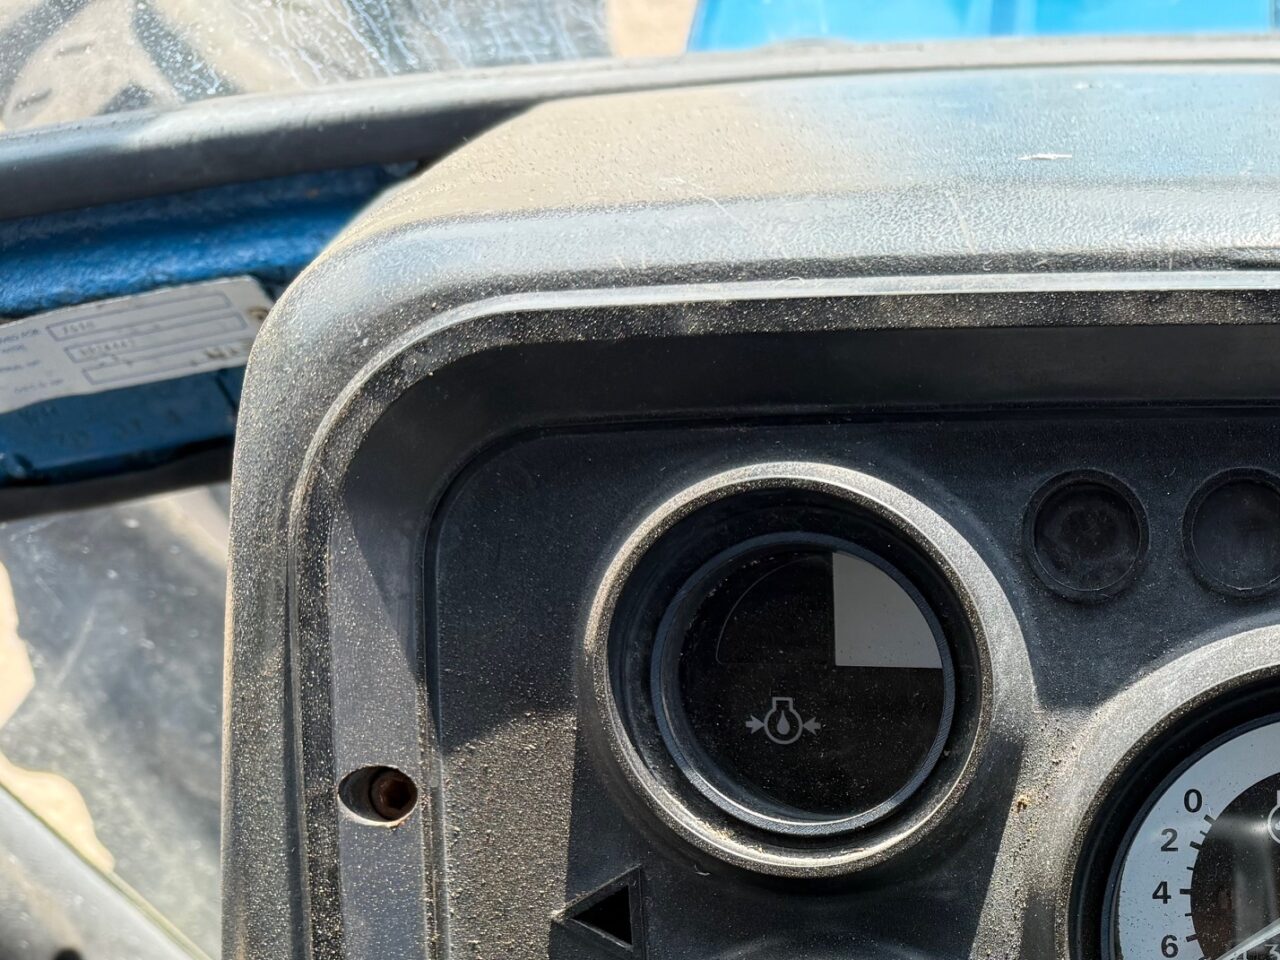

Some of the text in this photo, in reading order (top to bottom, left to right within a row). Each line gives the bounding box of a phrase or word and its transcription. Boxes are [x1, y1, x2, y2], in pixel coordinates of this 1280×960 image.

[1183, 789, 1203, 813] 0
[1160, 828, 1179, 852] 2
[1152, 881, 1172, 904] 4
[1160, 934, 1179, 959] 6
